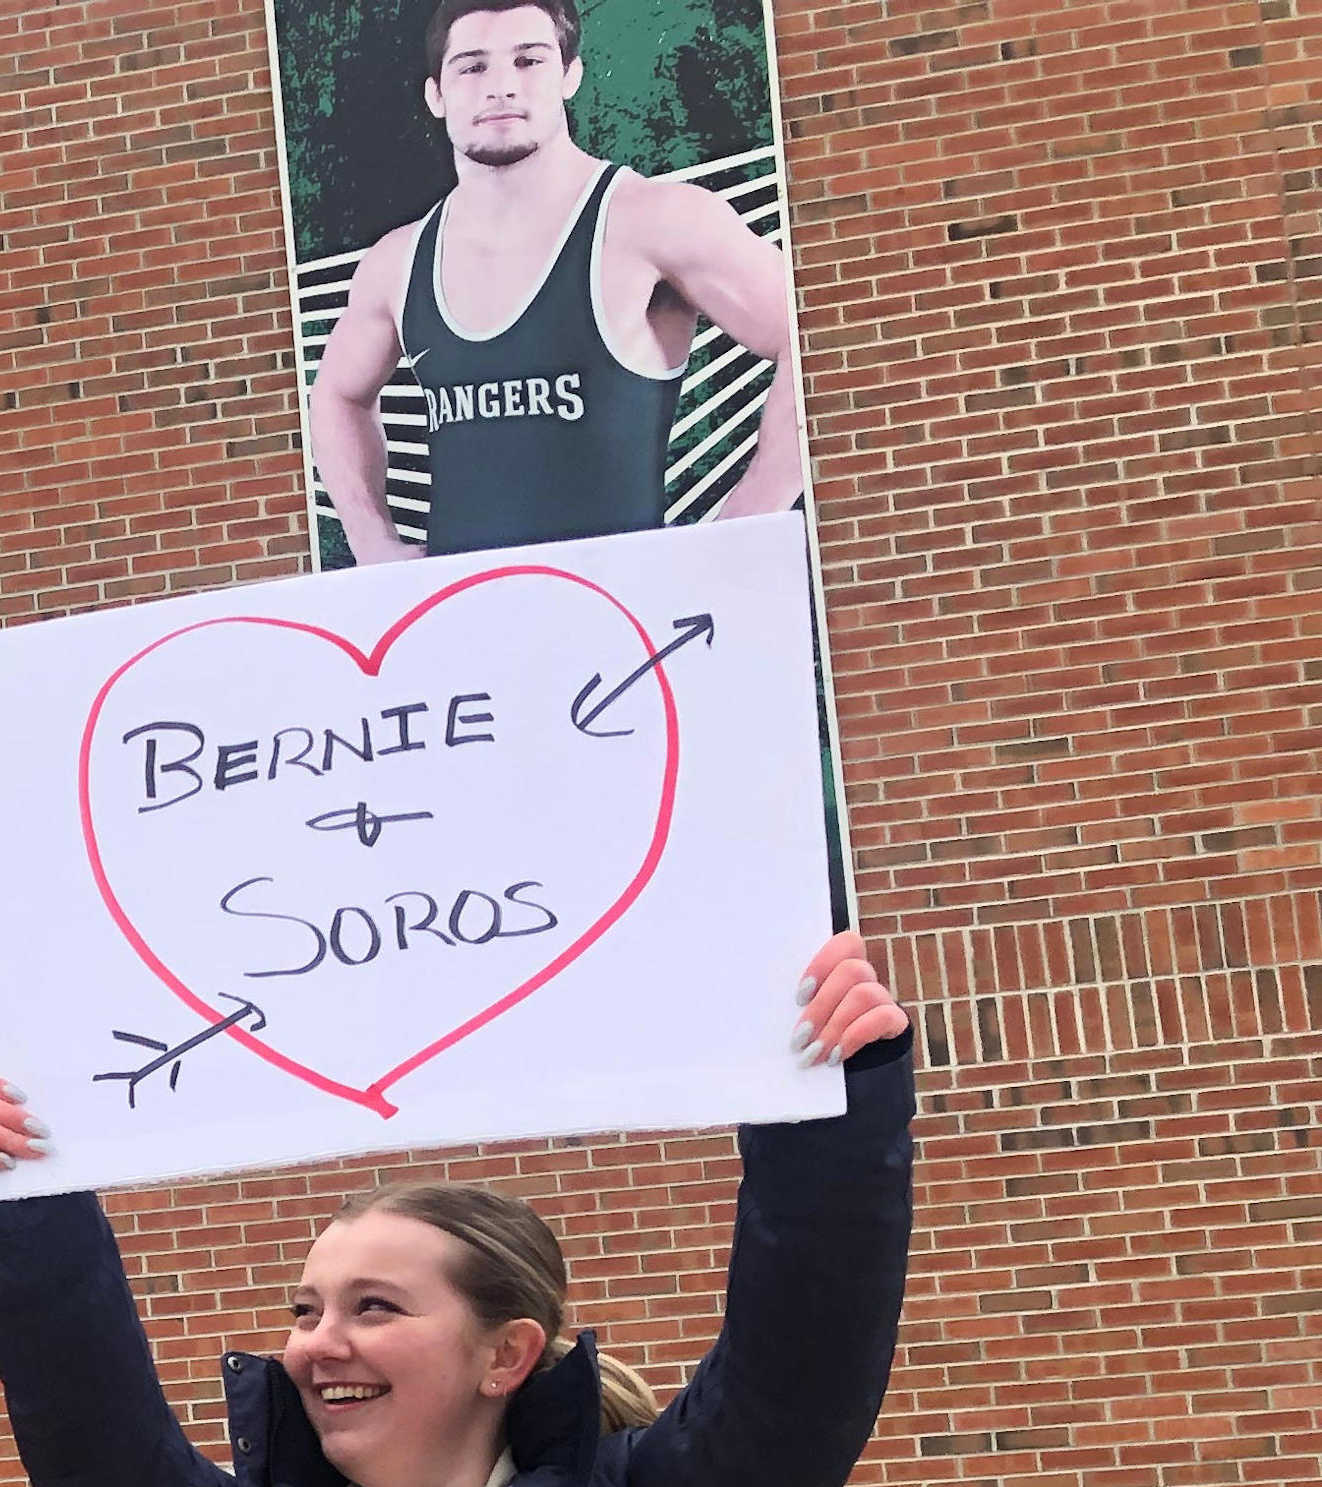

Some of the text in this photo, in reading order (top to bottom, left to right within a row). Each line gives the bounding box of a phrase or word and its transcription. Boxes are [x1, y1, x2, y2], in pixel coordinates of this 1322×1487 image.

[423, 373, 585, 433] RANGERS
[122, 691, 496, 814] BERNIE
[219, 876, 559, 978] SOROS
